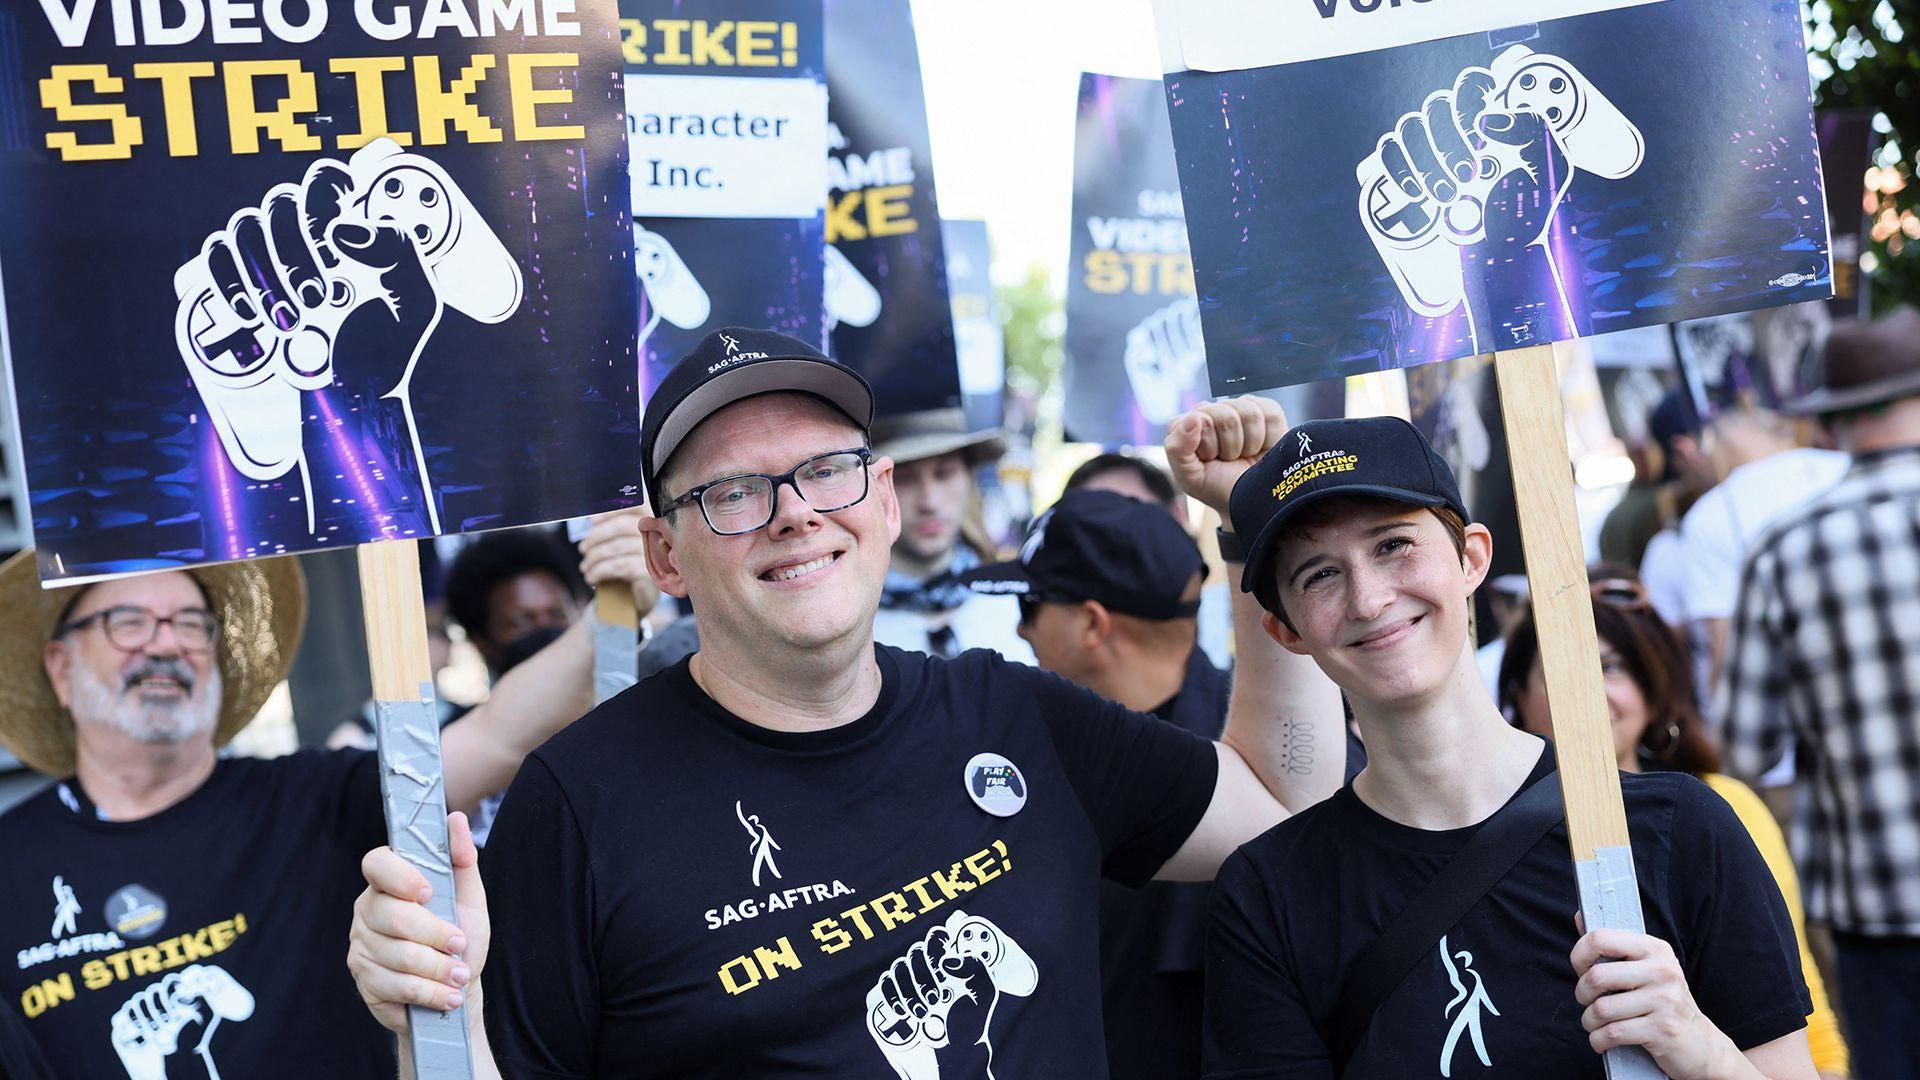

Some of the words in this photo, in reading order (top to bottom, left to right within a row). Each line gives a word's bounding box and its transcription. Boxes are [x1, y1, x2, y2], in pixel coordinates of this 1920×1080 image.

[39, 0, 328, 47] VIDEO
[354, 0, 582, 41] GAME
[38, 52, 587, 161] STRIKE
[650, 160, 723, 188] Inc.
[1271, 454, 1358, 497] NEGOTIATING
[1278, 462, 1355, 501] COMMITTEE
[983, 767, 1004, 776] PLAY
[986, 777, 1006, 786] FAIR
[717, 936, 803, 996] ON
[811, 839, 1012, 955] STRIKE!
[21, 971, 76, 1019] ON
